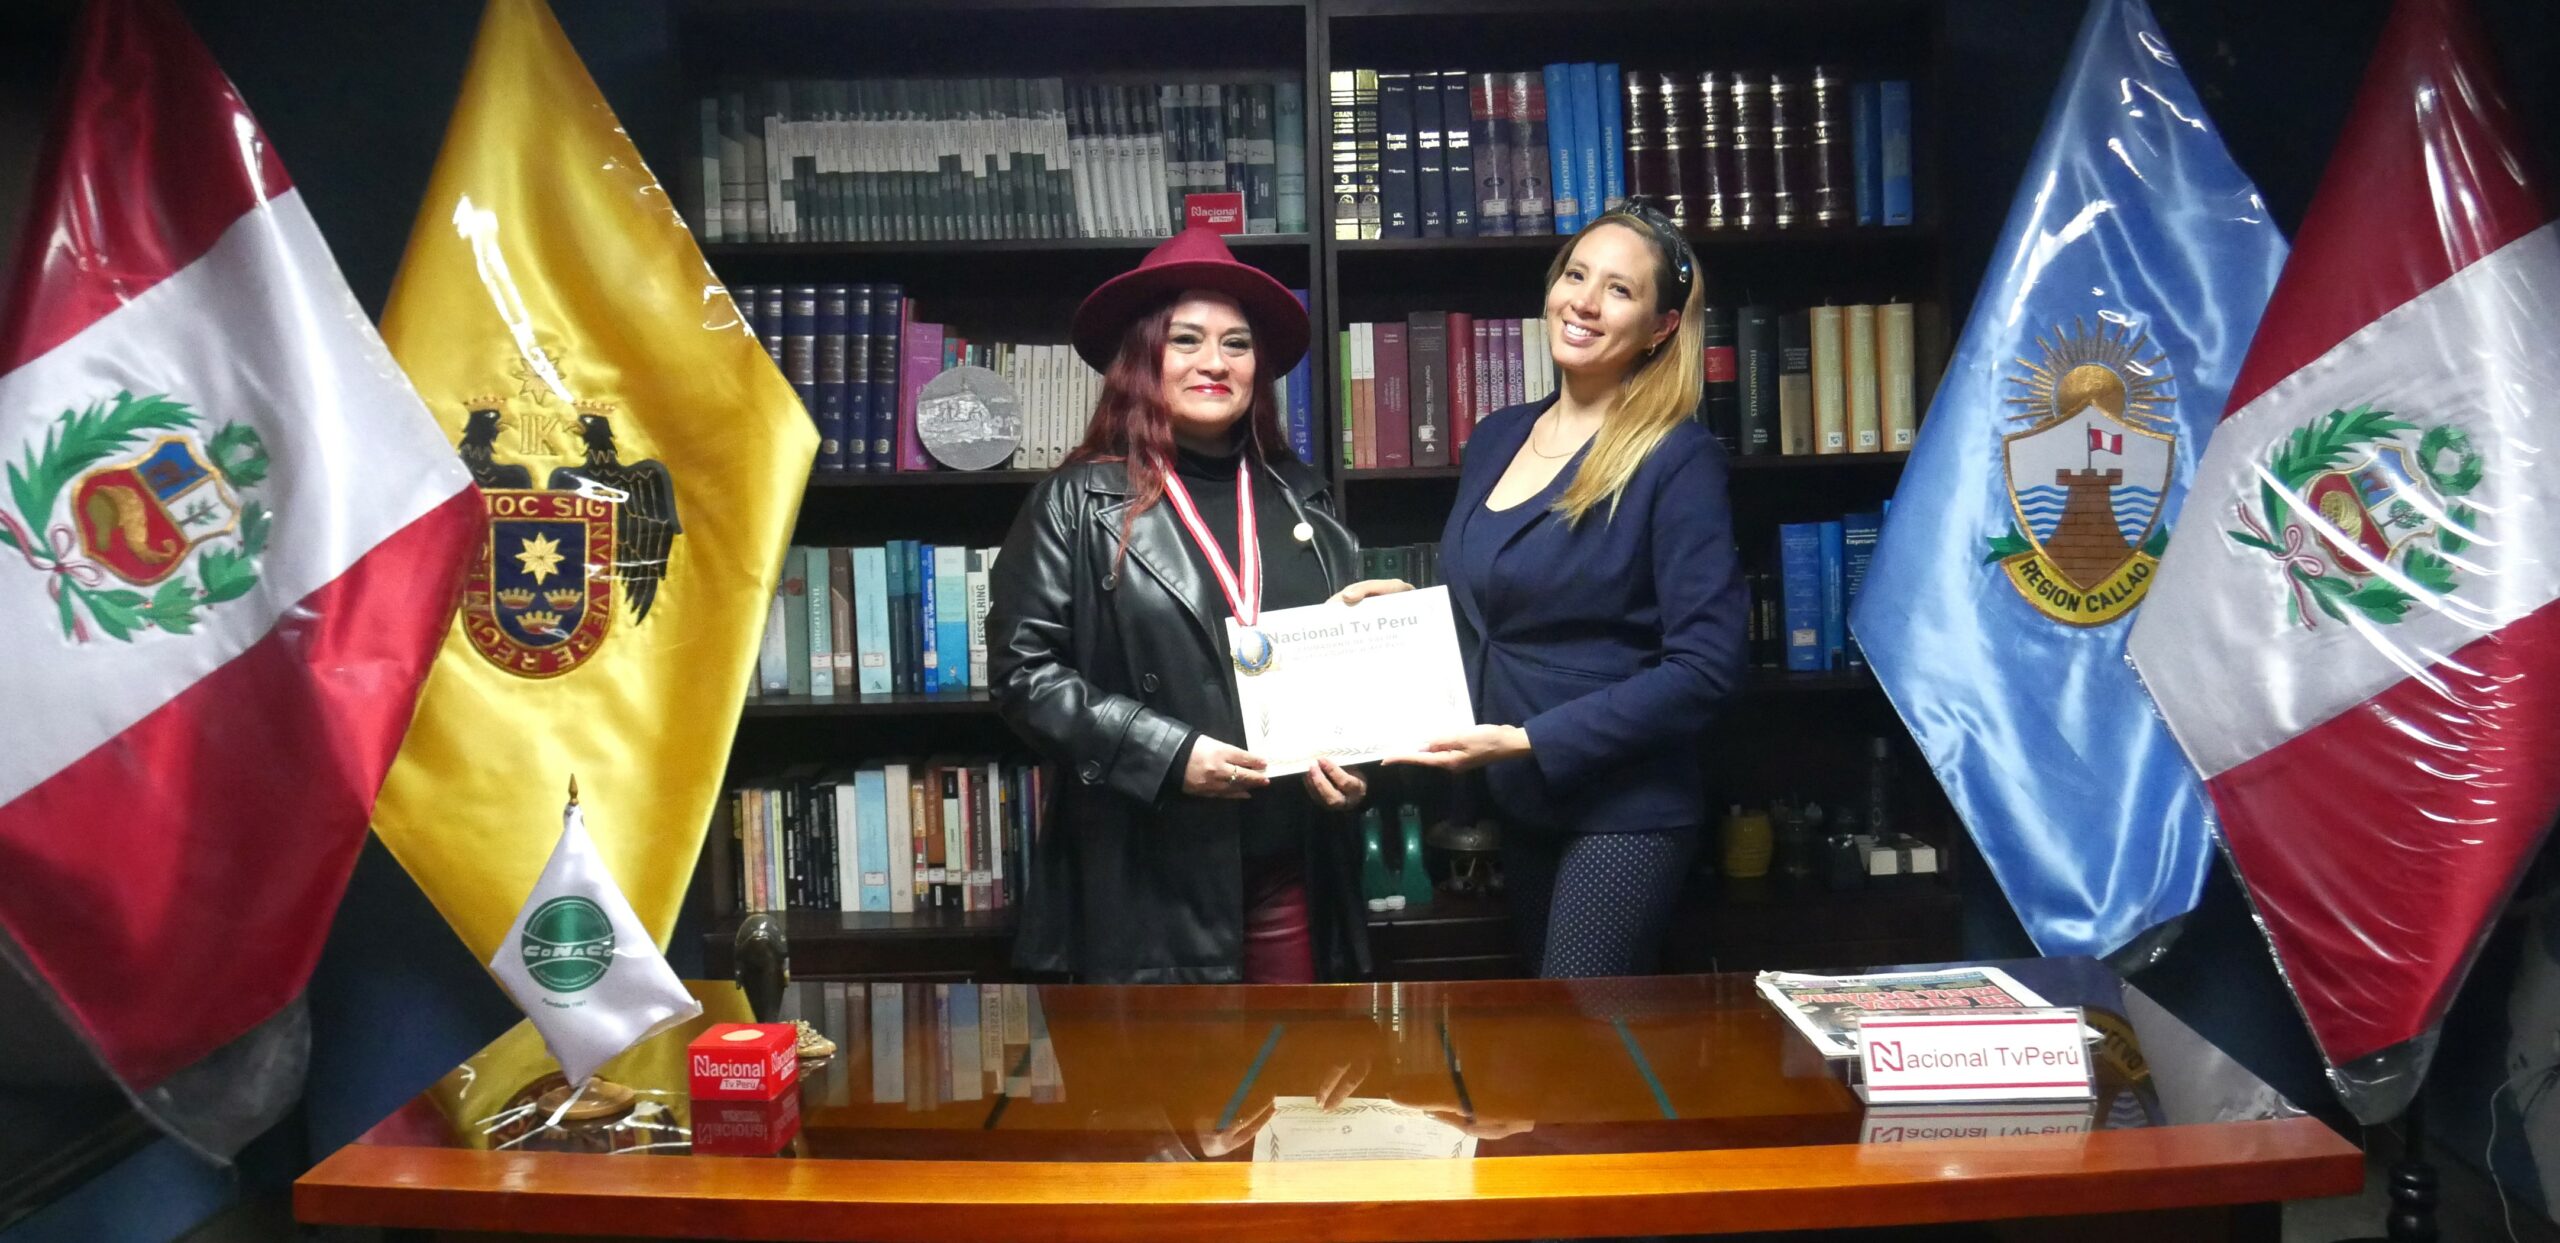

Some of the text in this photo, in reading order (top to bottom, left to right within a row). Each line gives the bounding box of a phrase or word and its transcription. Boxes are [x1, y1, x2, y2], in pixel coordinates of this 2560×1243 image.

[1341, 174, 1350, 184] 3
[1191, 206, 1238, 217] Nacional
[2019, 558, 2150, 613] REGION CALLAO
[976, 584, 986, 646] KESSELRING
[1267, 624, 1345, 645] Nacional
[1350, 621, 1371, 634] Tv
[1377, 615, 1418, 631] Peru
[1855, 996, 1972, 1010] GUERRA
[693, 1055, 766, 1077] Nacional
[1870, 1041, 1988, 1072] Nacional
